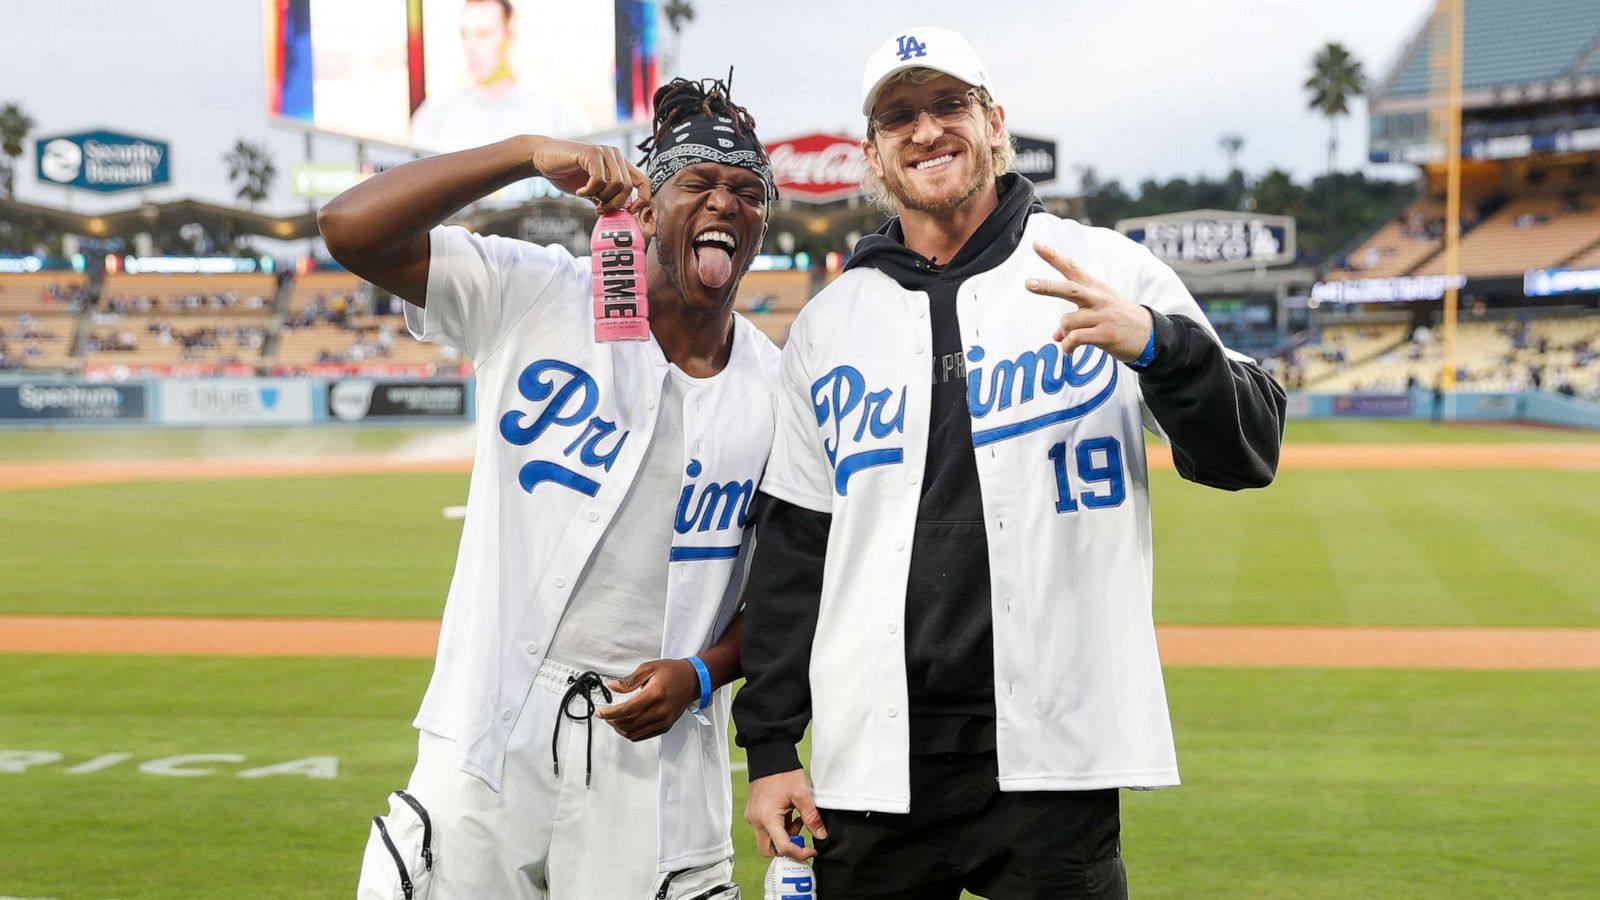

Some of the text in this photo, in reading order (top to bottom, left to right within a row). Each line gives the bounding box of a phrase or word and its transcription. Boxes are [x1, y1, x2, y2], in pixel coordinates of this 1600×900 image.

[896, 35, 927, 61] LA
[82, 140, 164, 169] Security
[85, 158, 152, 184] Benefit
[600, 230, 637, 319] PRIME
[18, 383, 117, 412] Spectrum
[190, 387, 249, 409] blue
[1048, 435, 1126, 514] 19
